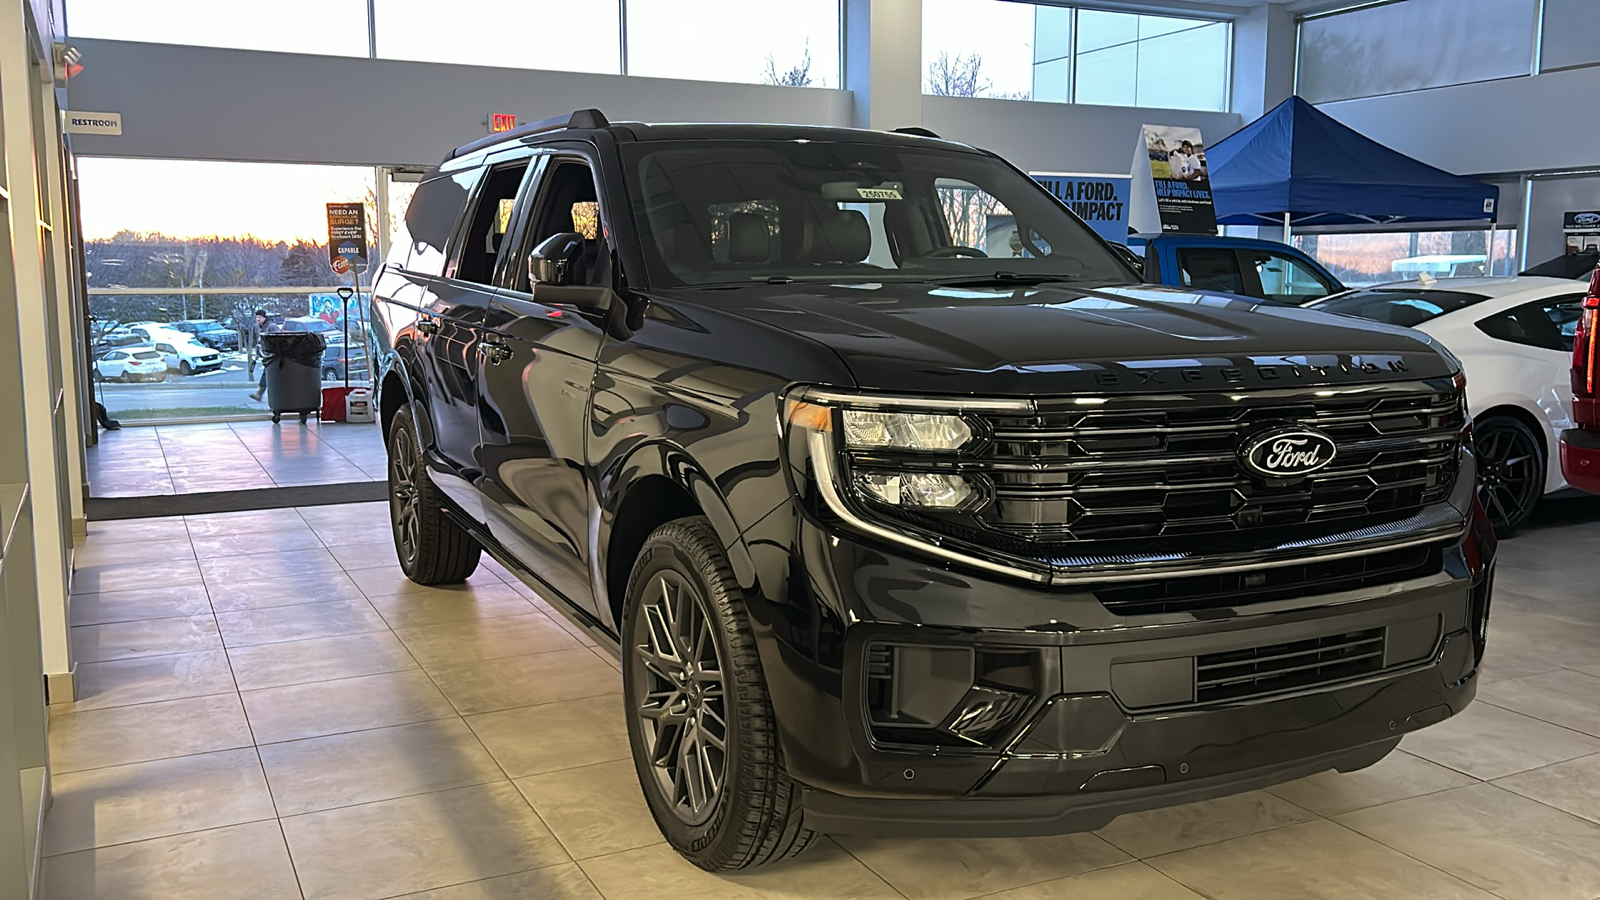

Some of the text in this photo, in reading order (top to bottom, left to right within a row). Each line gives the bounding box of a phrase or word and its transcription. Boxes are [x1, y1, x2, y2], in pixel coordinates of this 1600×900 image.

[71, 118, 118, 128] RESTROOM
[493, 113, 516, 132] EXIT
[1064, 181, 1074, 200] A
[1076, 181, 1118, 202] FORD.
[1157, 188, 1171, 197] HELP
[1072, 201, 1123, 221] IMPACT
[1266, 438, 1321, 469] Ford
